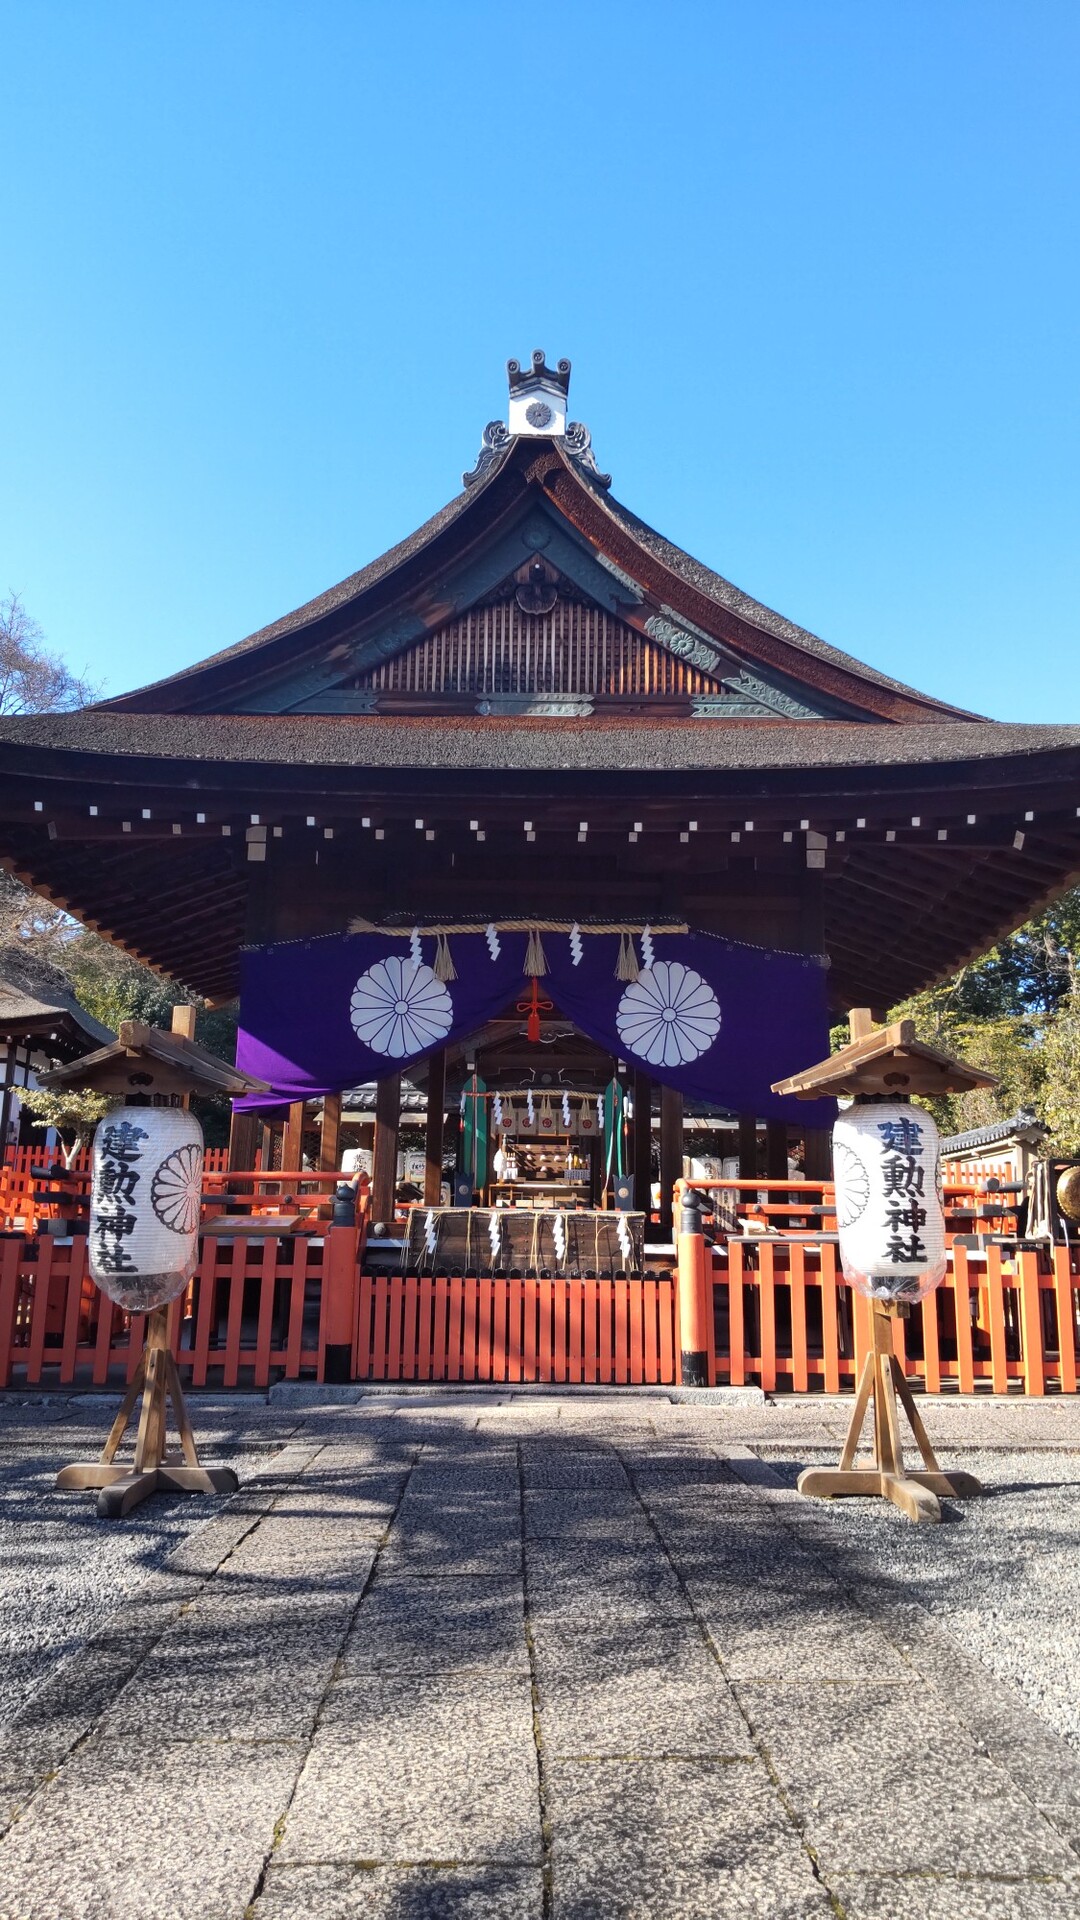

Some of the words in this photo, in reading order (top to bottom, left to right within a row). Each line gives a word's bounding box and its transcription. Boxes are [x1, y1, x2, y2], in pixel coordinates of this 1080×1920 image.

[94, 1121, 149, 1273] 建勲神社
[877, 1117, 928, 1264] 建勲神社
